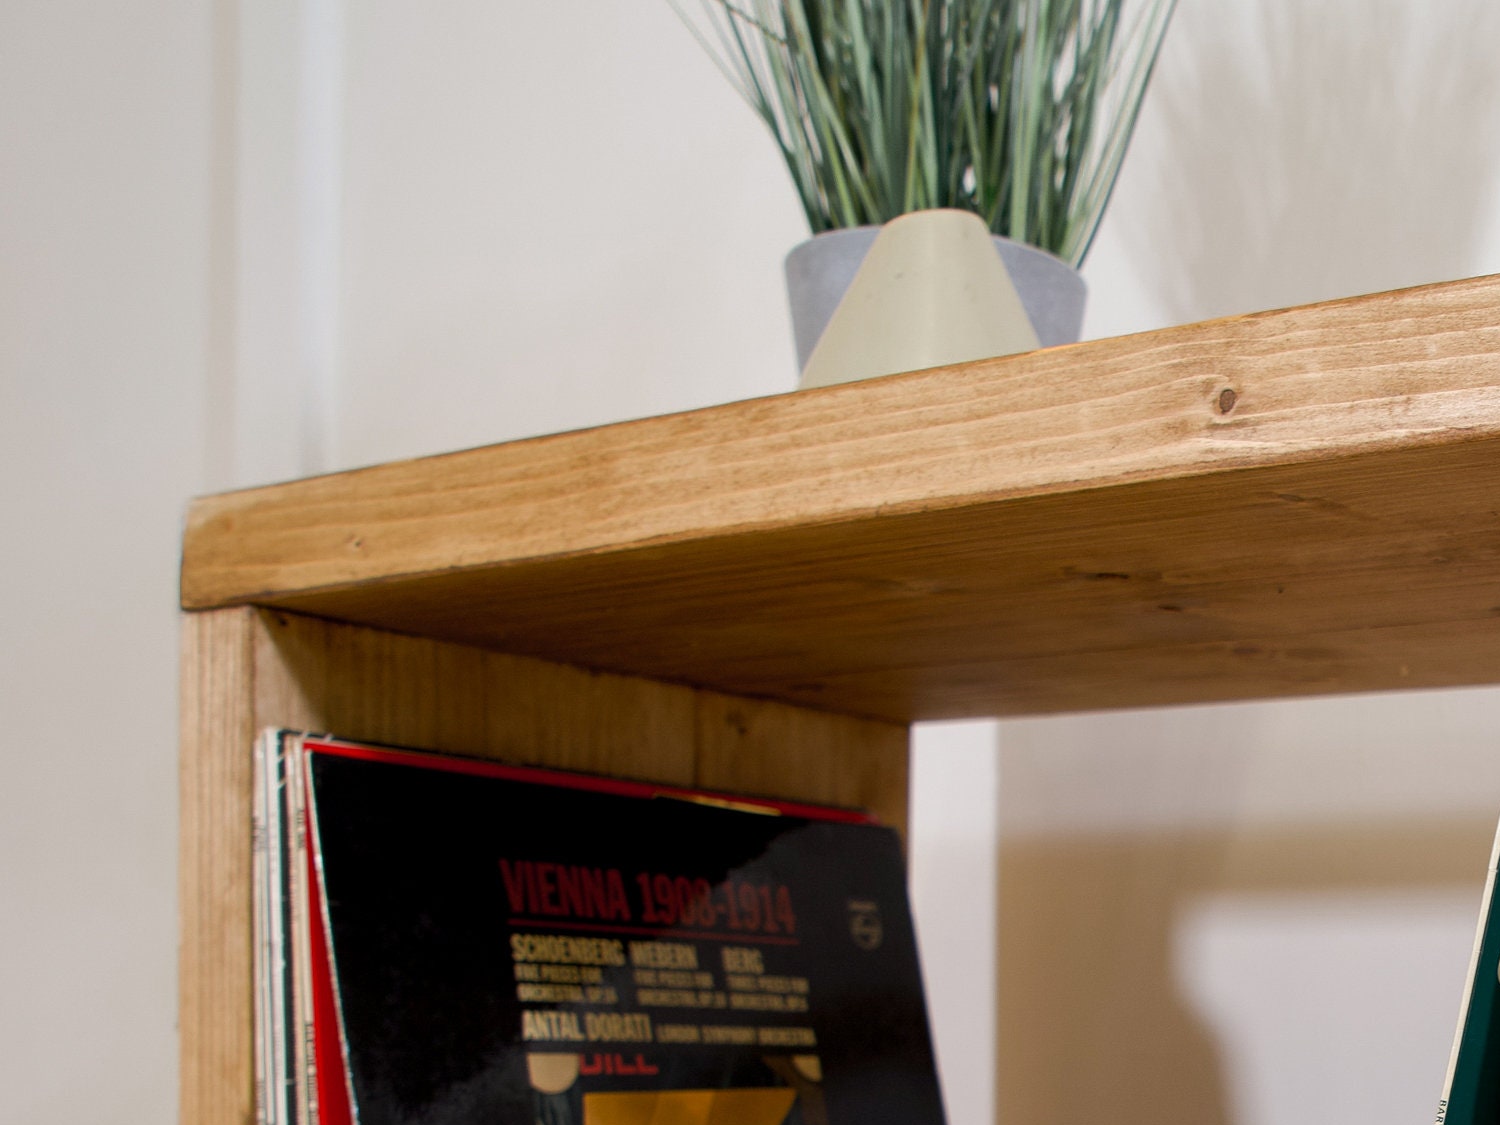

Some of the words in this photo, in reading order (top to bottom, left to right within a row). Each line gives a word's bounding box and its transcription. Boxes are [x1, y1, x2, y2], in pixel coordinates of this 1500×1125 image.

[498, 857, 632, 921] VIENNA
[634, 871, 797, 935] 1908-1914
[509, 932, 626, 967] SCHOENBERG
[721, 946, 765, 975] BERG
[520, 1010, 585, 1042] ANTAL
[584, 1012, 653, 1042] DORATI
